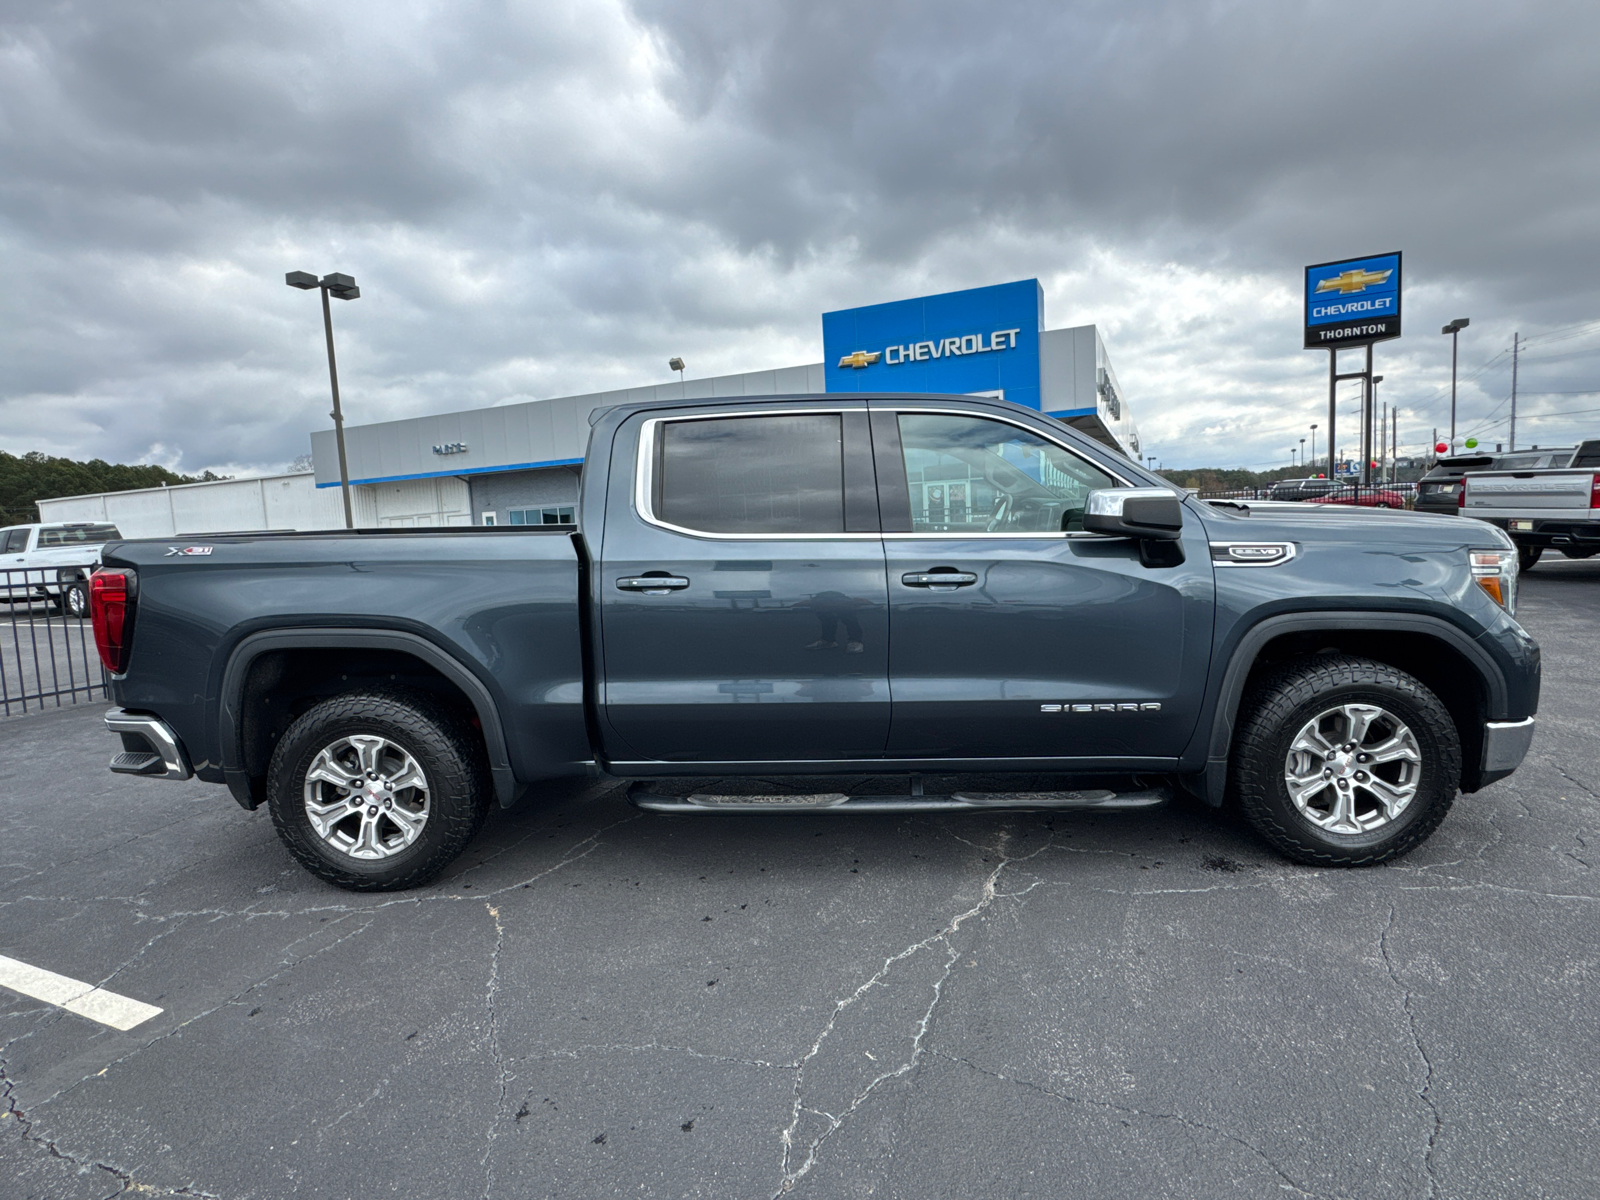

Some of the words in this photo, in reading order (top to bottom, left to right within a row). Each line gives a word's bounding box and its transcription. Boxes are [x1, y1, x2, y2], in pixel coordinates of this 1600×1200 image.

[1313, 297, 1392, 317] CHEVROLET
[1319, 323, 1386, 340] THORNTON
[885, 328, 1020, 365] CHEVROLET
[1469, 483, 1579, 492] CHEVROLET
[1040, 702, 1161, 713] SIERRA
